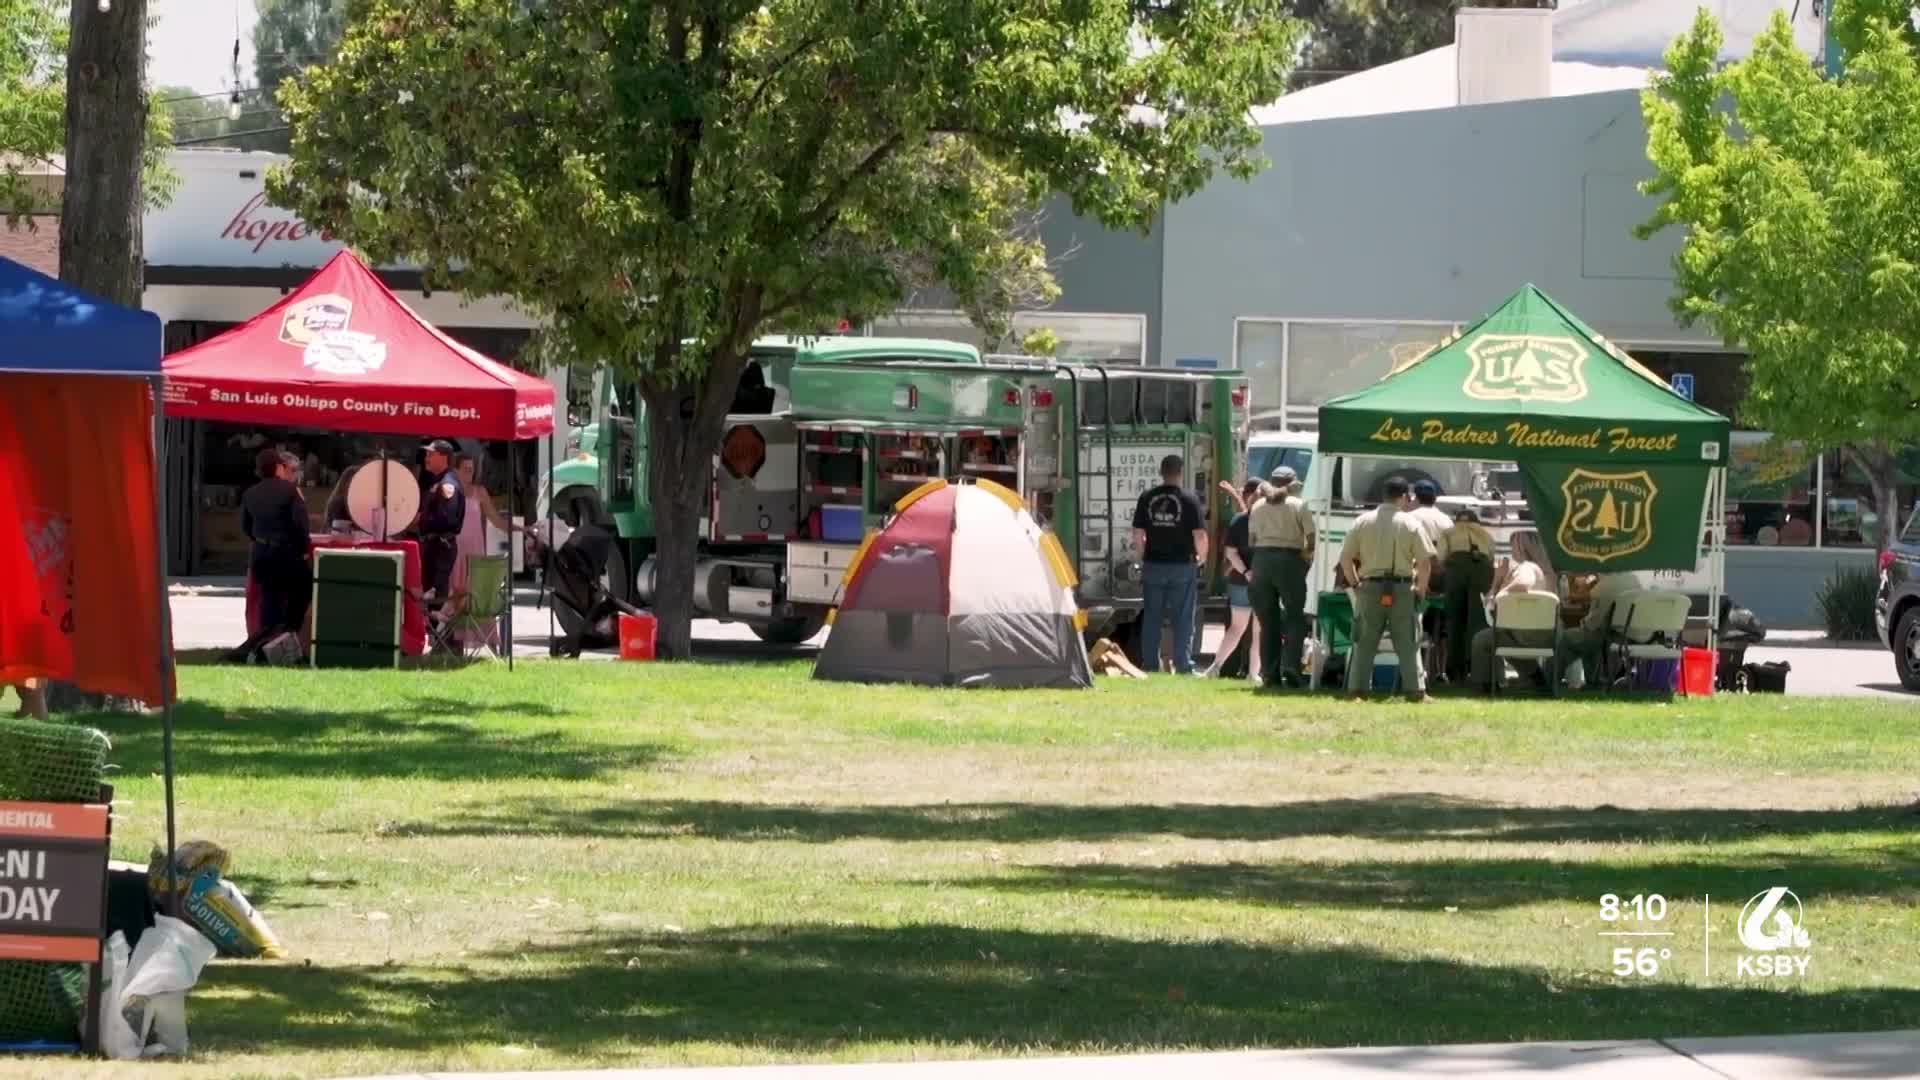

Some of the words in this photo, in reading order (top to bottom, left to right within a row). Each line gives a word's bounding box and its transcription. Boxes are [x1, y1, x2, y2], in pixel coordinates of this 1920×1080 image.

[221, 191, 306, 253] hope
[210, 388, 240, 402] San
[245, 391, 278, 405] Luis
[283, 393, 338, 410] Obispo
[343, 398, 398, 416] County
[403, 402, 434, 416] Fire
[439, 404, 480, 420] Dept.
[1370, 417, 1412, 441] Los
[1421, 419, 1498, 444] Padres
[1505, 421, 1602, 449] National
[1608, 427, 1678, 453] Forest
[1120, 455, 1155, 465] USDA
